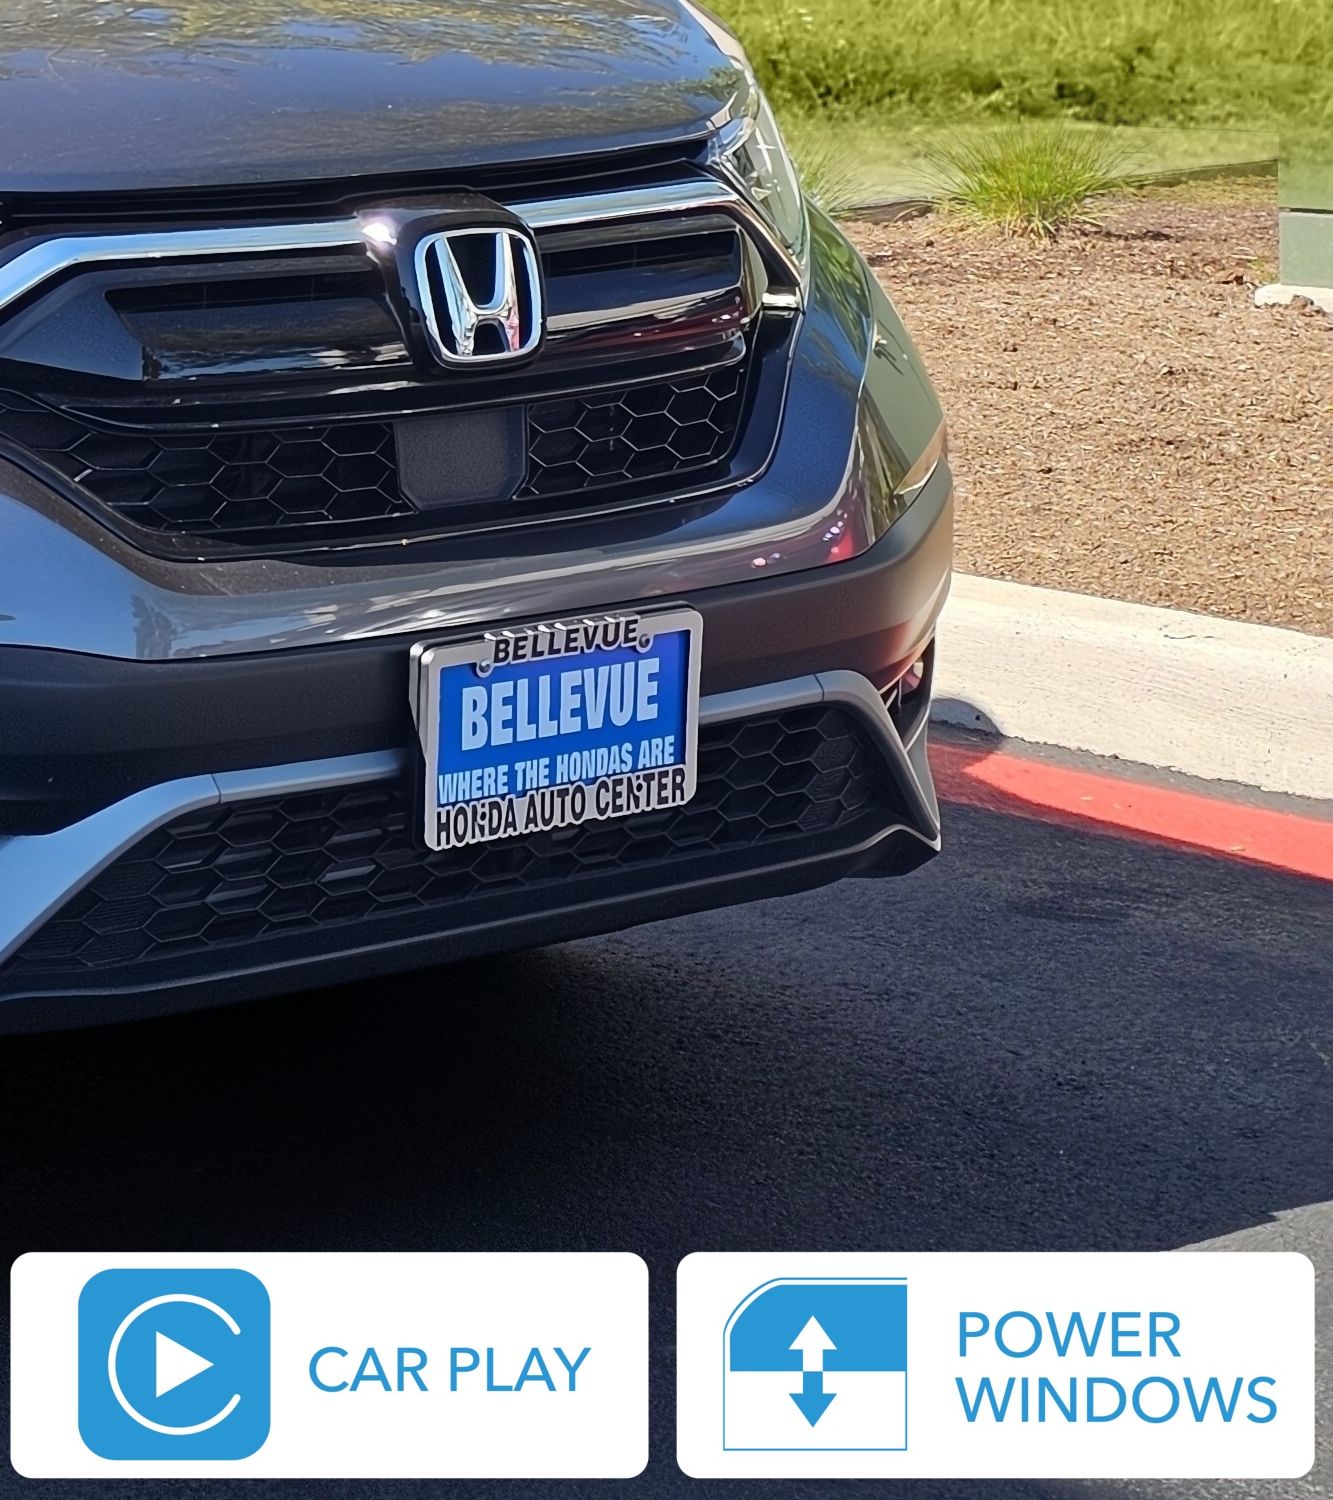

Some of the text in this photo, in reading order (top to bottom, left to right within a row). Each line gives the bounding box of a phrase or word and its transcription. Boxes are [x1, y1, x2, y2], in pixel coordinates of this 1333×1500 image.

[493, 618, 640, 664] BELLEVUE
[461, 657, 660, 752] BELLEVUE
[438, 735, 675, 805] WHERE THE HONDAS ARE
[436, 768, 686, 848] HONDA AUTO CENTER
